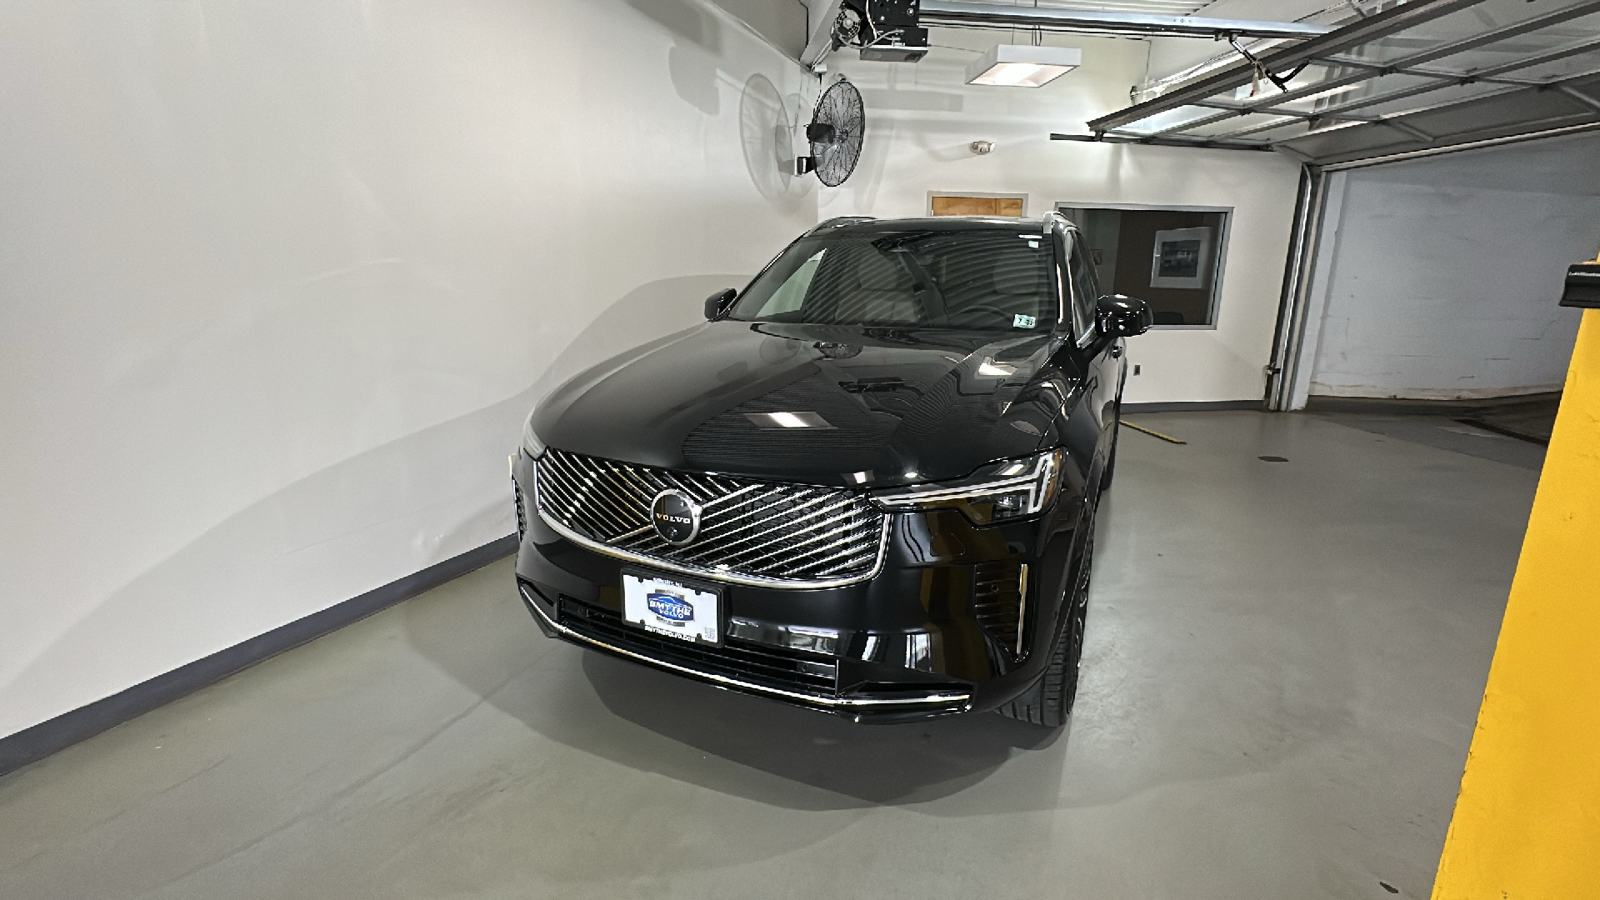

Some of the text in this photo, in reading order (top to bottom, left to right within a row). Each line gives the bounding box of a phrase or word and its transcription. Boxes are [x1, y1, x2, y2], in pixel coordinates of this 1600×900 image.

[656, 512, 691, 524] VOLVO
[650, 600, 692, 616] SMYTHE
[659, 608, 684, 619] VOLVO
